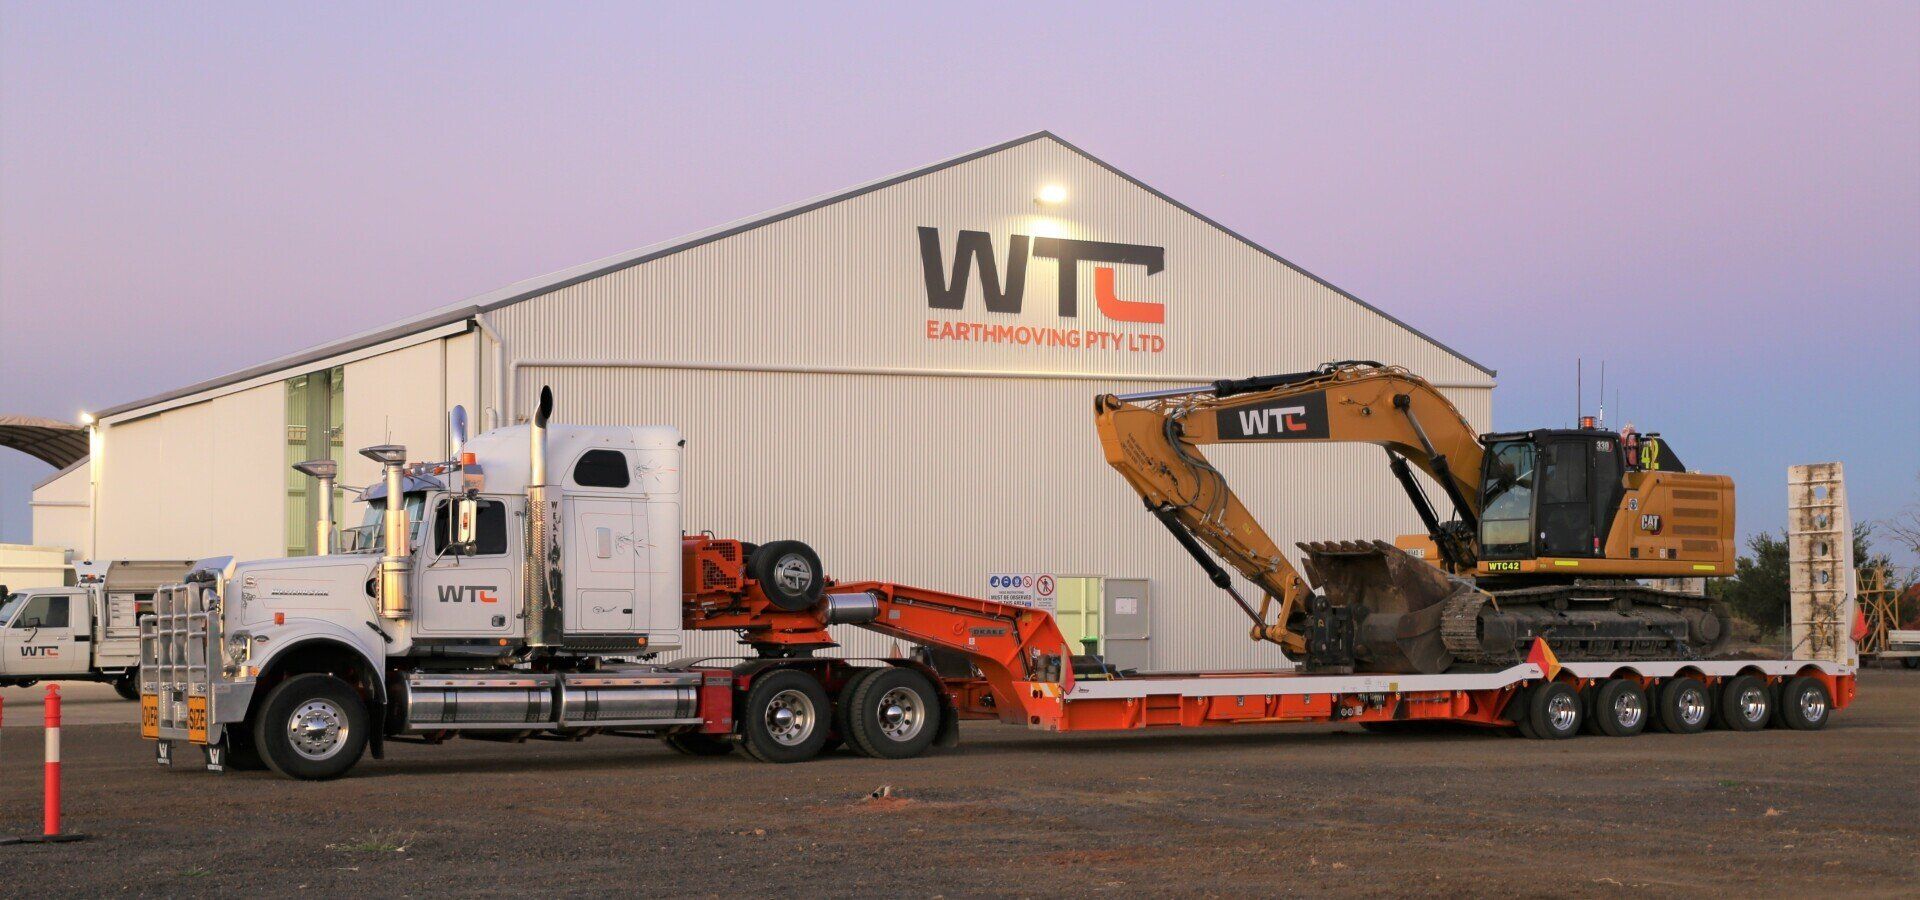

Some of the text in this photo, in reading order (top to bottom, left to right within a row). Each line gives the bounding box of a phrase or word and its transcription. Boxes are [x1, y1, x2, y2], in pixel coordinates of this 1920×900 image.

[917, 226, 1164, 324] WTC
[927, 319, 1165, 353] EARTHMOVING PTY LTD
[1239, 406, 1307, 436] WTC
[1596, 441, 1610, 451] 330
[1641, 440, 1659, 470] 42
[1641, 515, 1659, 530] CAT
[1489, 562, 1519, 571] WTC42
[437, 585, 498, 602] WTC
[21, 646, 58, 656] WTC
[190, 708, 205, 730] SIZE
